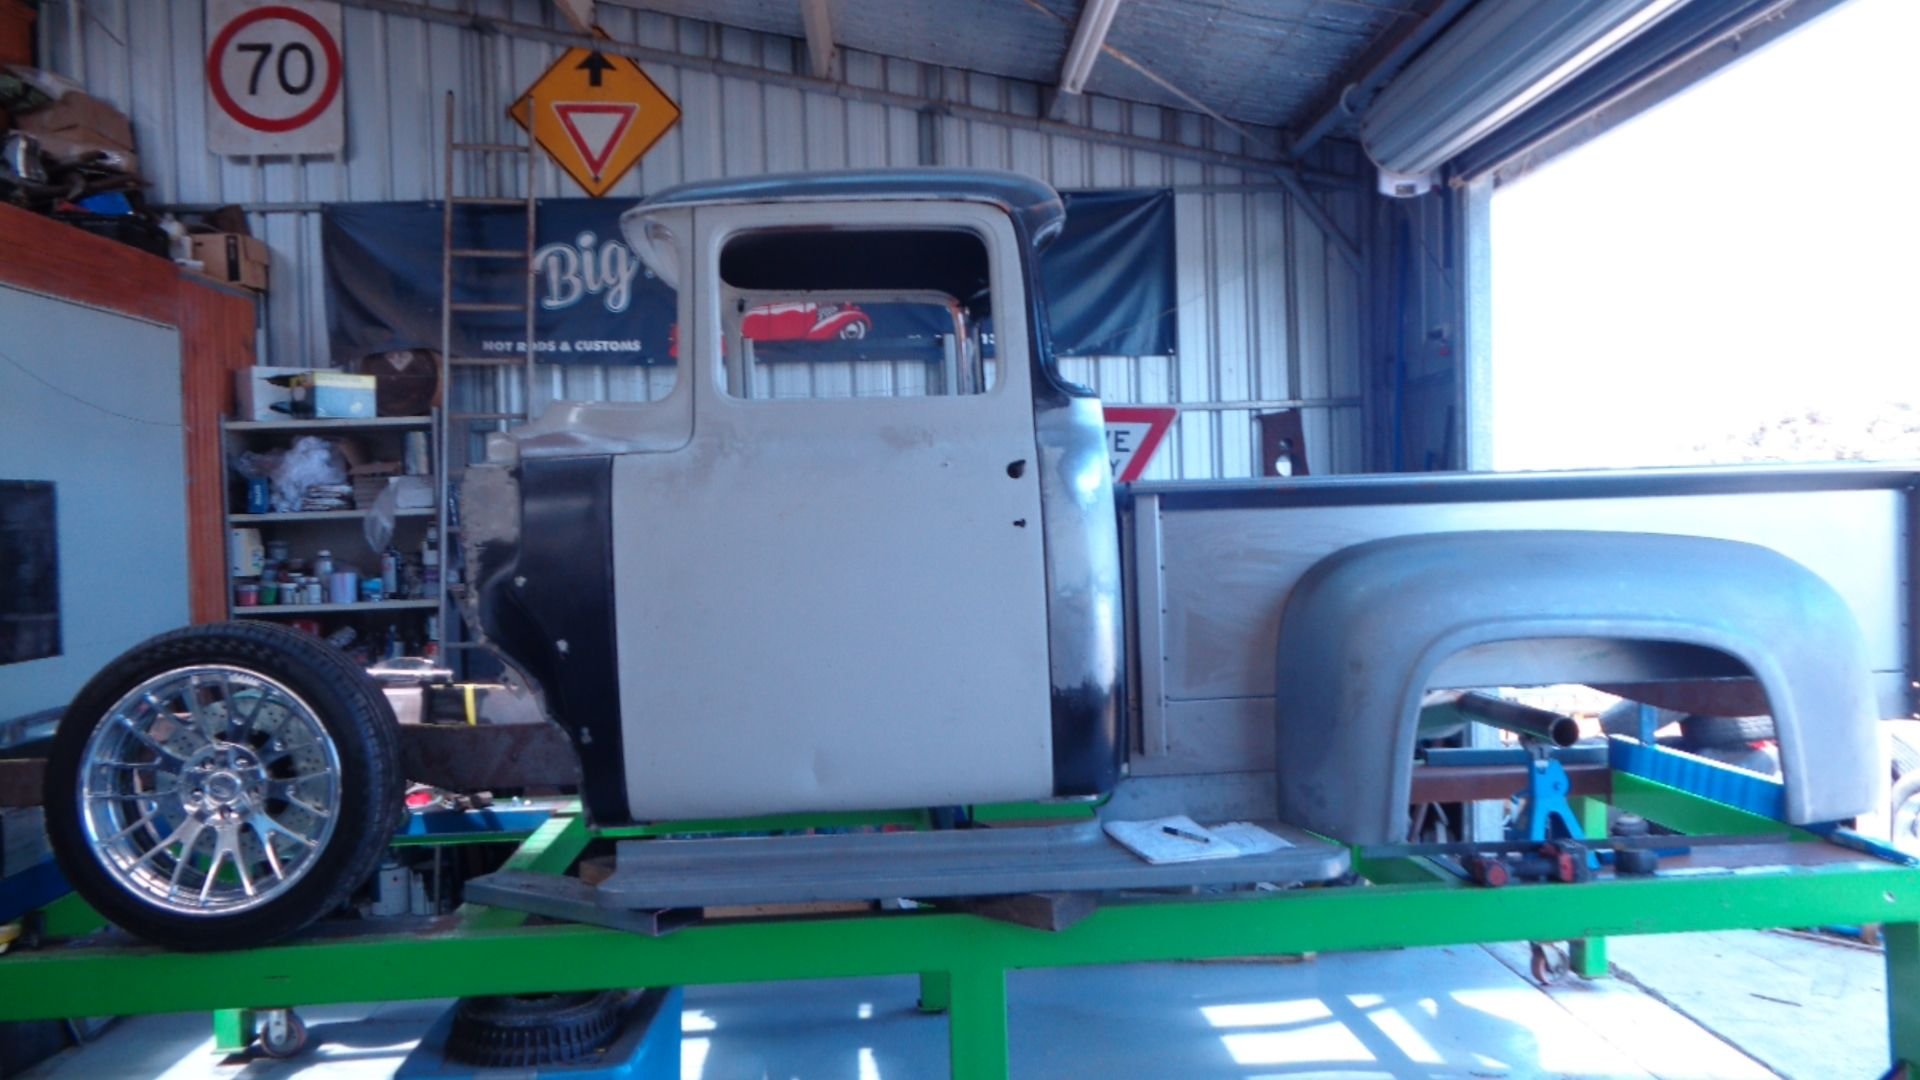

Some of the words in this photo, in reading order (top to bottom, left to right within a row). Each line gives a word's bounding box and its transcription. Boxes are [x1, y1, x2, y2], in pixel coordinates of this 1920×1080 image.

[237, 42, 315, 96] 70
[533, 230, 640, 313] Big
[482, 341, 513, 351] HOT
[575, 340, 642, 351] CUSTOMS
